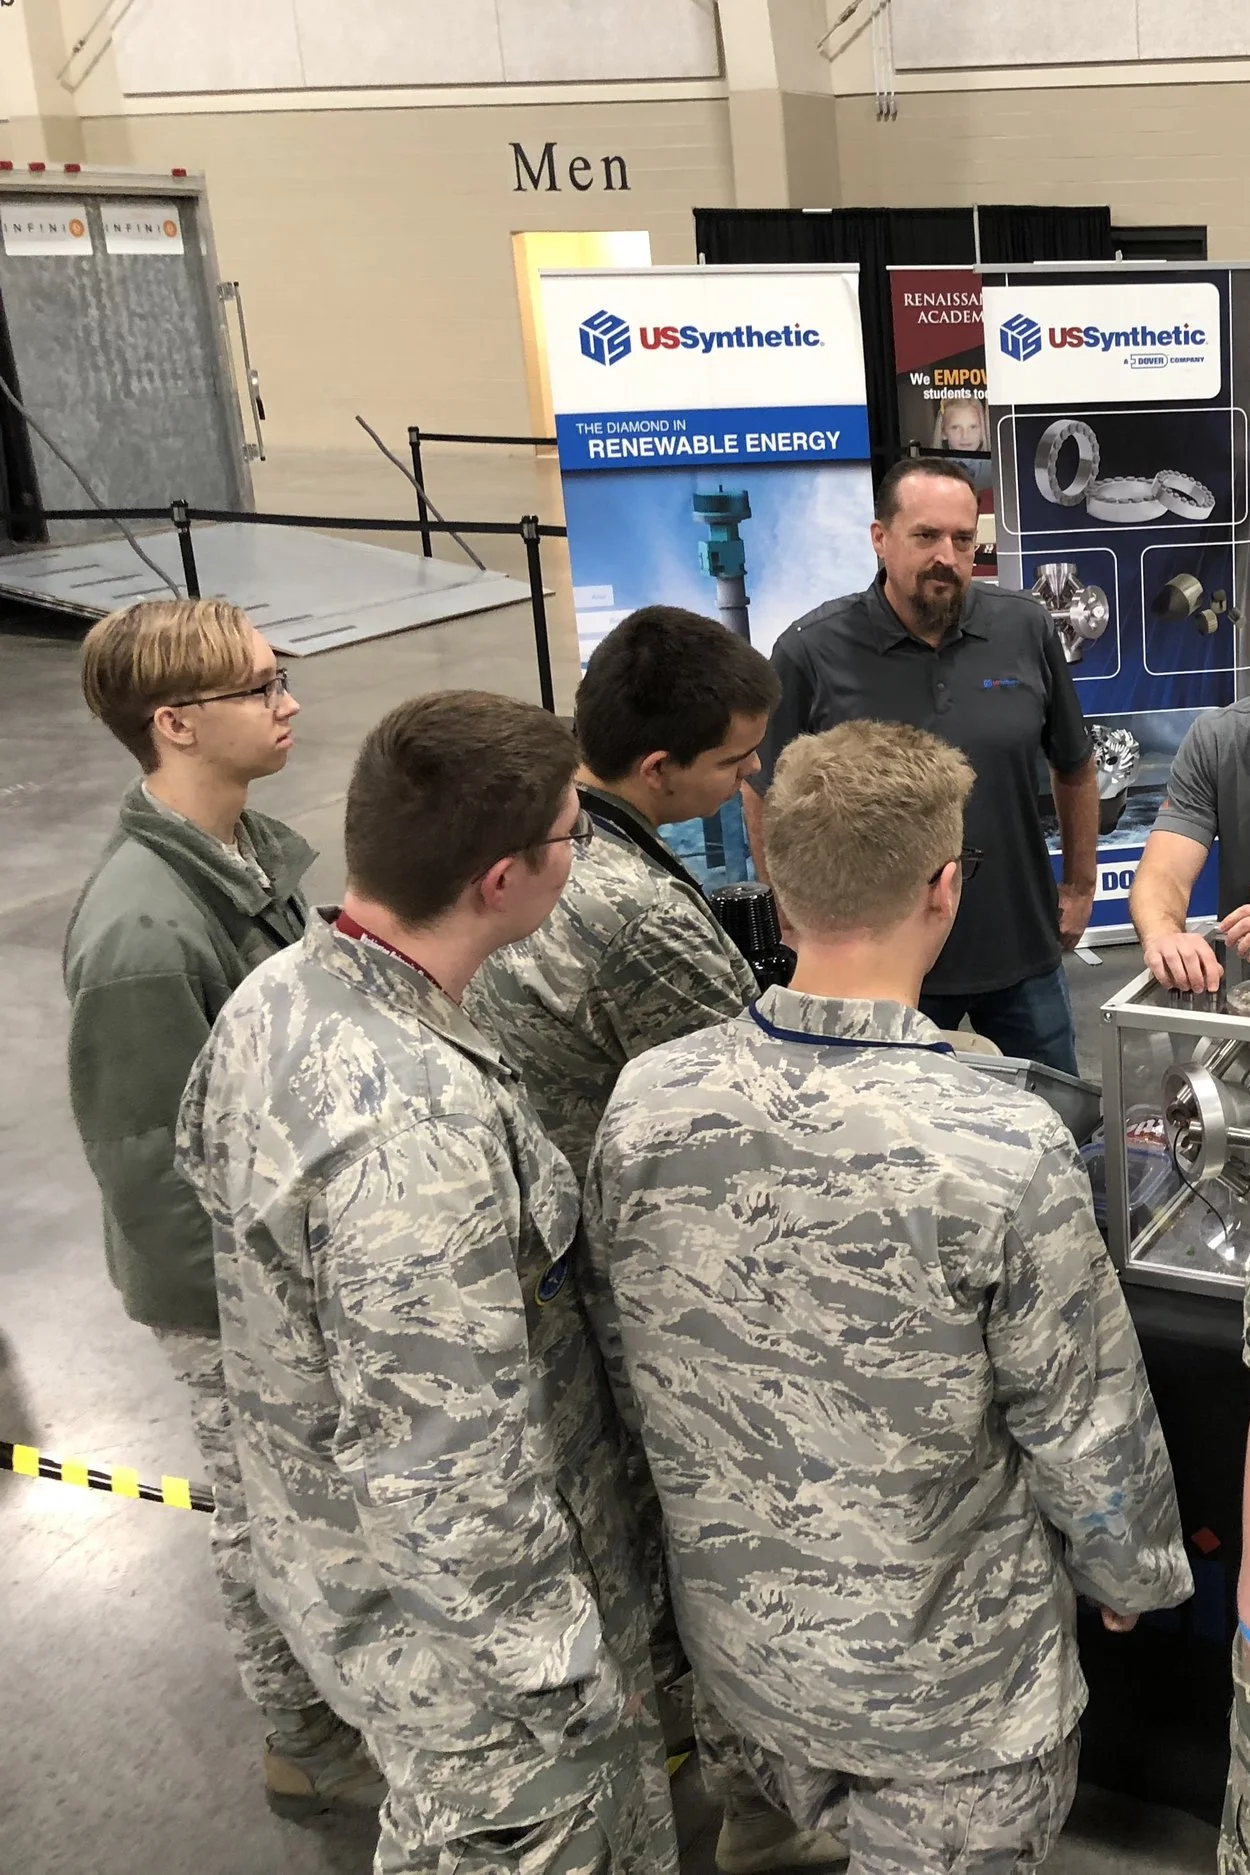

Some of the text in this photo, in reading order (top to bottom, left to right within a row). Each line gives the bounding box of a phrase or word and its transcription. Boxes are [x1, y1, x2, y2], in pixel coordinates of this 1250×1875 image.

[509, 142, 631, 192] Men
[639, 322, 821, 354] USSynthetic
[1049, 323, 1207, 352] USSynthetic
[1138, 357, 1164, 365] DOVER
[1170, 356, 1205, 364] COMPANY
[910, 372, 931, 385] We
[923, 386, 972, 400] students
[576, 419, 687, 435] THE DIAMOND IN
[588, 430, 841, 460] RENEWABLE ENERGY
